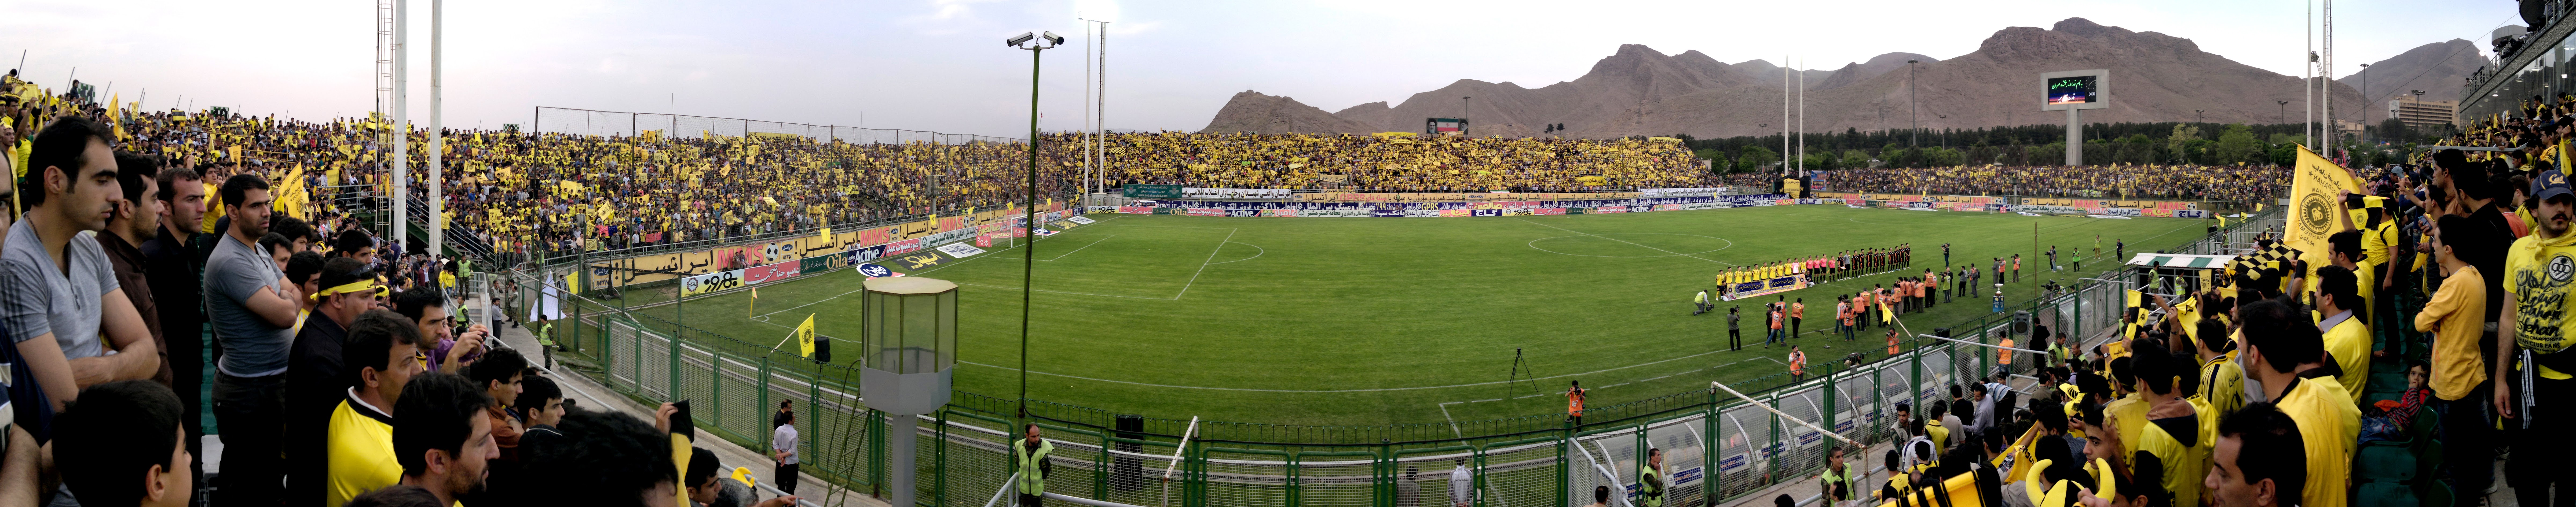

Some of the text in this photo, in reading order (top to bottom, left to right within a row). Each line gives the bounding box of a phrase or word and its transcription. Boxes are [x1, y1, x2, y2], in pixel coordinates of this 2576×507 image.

[2549, 174, 2565, 185] Cal
[1188, 188, 1290, 198] قهرمان واقعی شهیدان انقلاب اسلامی
[1340, 194, 1365, 202] GPRS
[1051, 202, 1062, 212] MMS
[1304, 202, 1321, 210] الملل
[2075, 199, 2099, 208] MMS
[2158, 202, 2186, 210] MMS
[941, 216, 963, 232] MMS
[978, 224, 1000, 236] صالحین
[1015, 228, 1025, 237] پدیده
[860, 227, 890, 248] MMS
[928, 235, 938, 247] مشیز
[938, 233, 946, 245] گستر
[978, 237, 988, 247] پدیده
[886, 238, 920, 255] آبمیوه مینوت مید
[855, 247, 879, 263] Active
[826, 253, 848, 269] Oila
[786, 267, 800, 277] شامپو
[704, 272, 738, 293] بهروز
[1720, 459, 1744, 469] the-AFC.com
[1674, 470, 1702, 481] the-AFC.com
